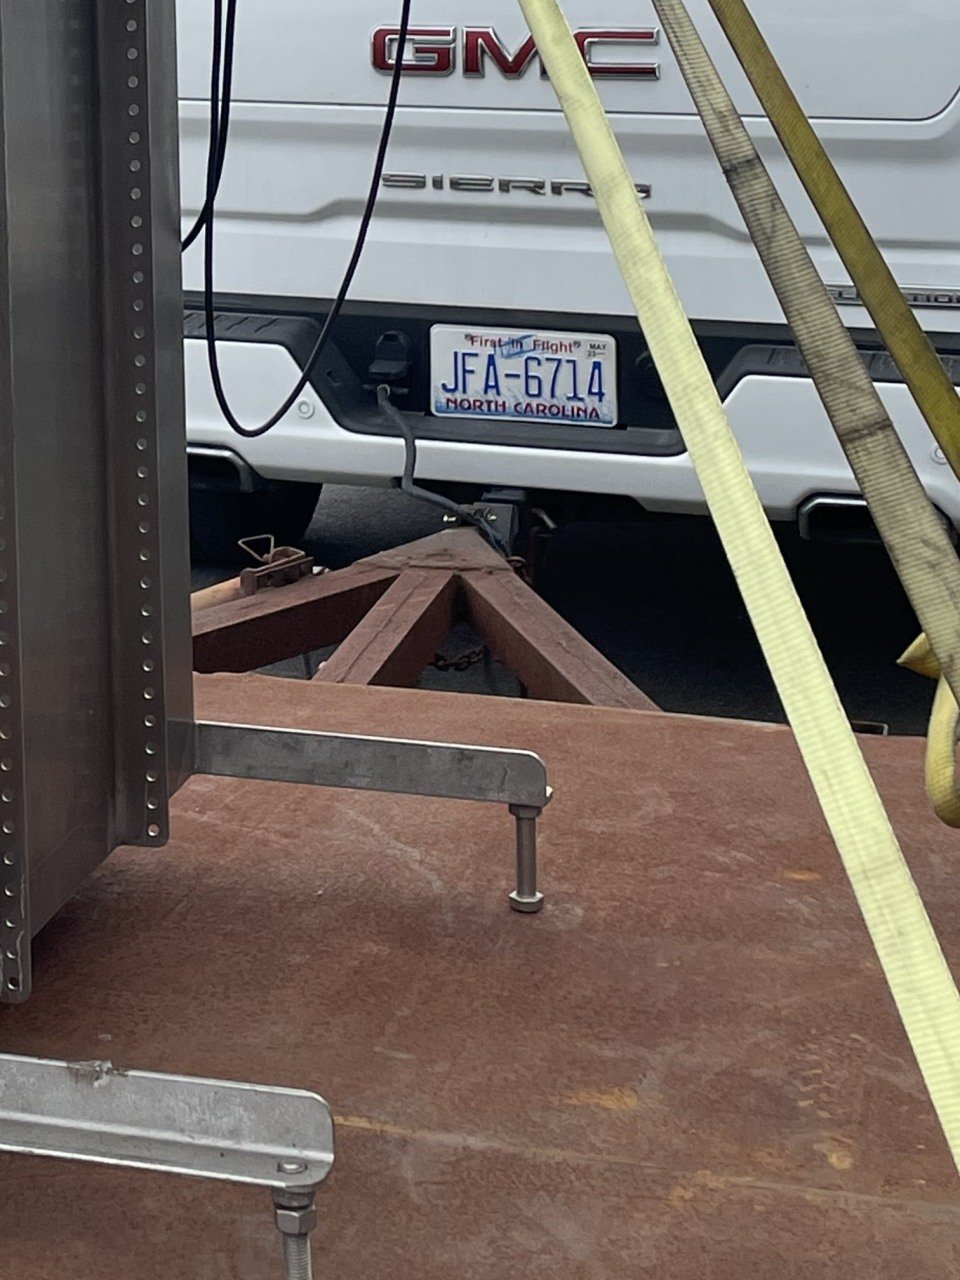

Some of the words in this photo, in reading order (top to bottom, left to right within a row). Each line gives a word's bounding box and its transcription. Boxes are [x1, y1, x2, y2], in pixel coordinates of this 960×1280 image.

[371, 25, 660, 80] GMC
[441, 350, 606, 403] JFA-6714
[445, 397, 507, 413] NORTH
[513, 401, 601, 420] CAROLINA
